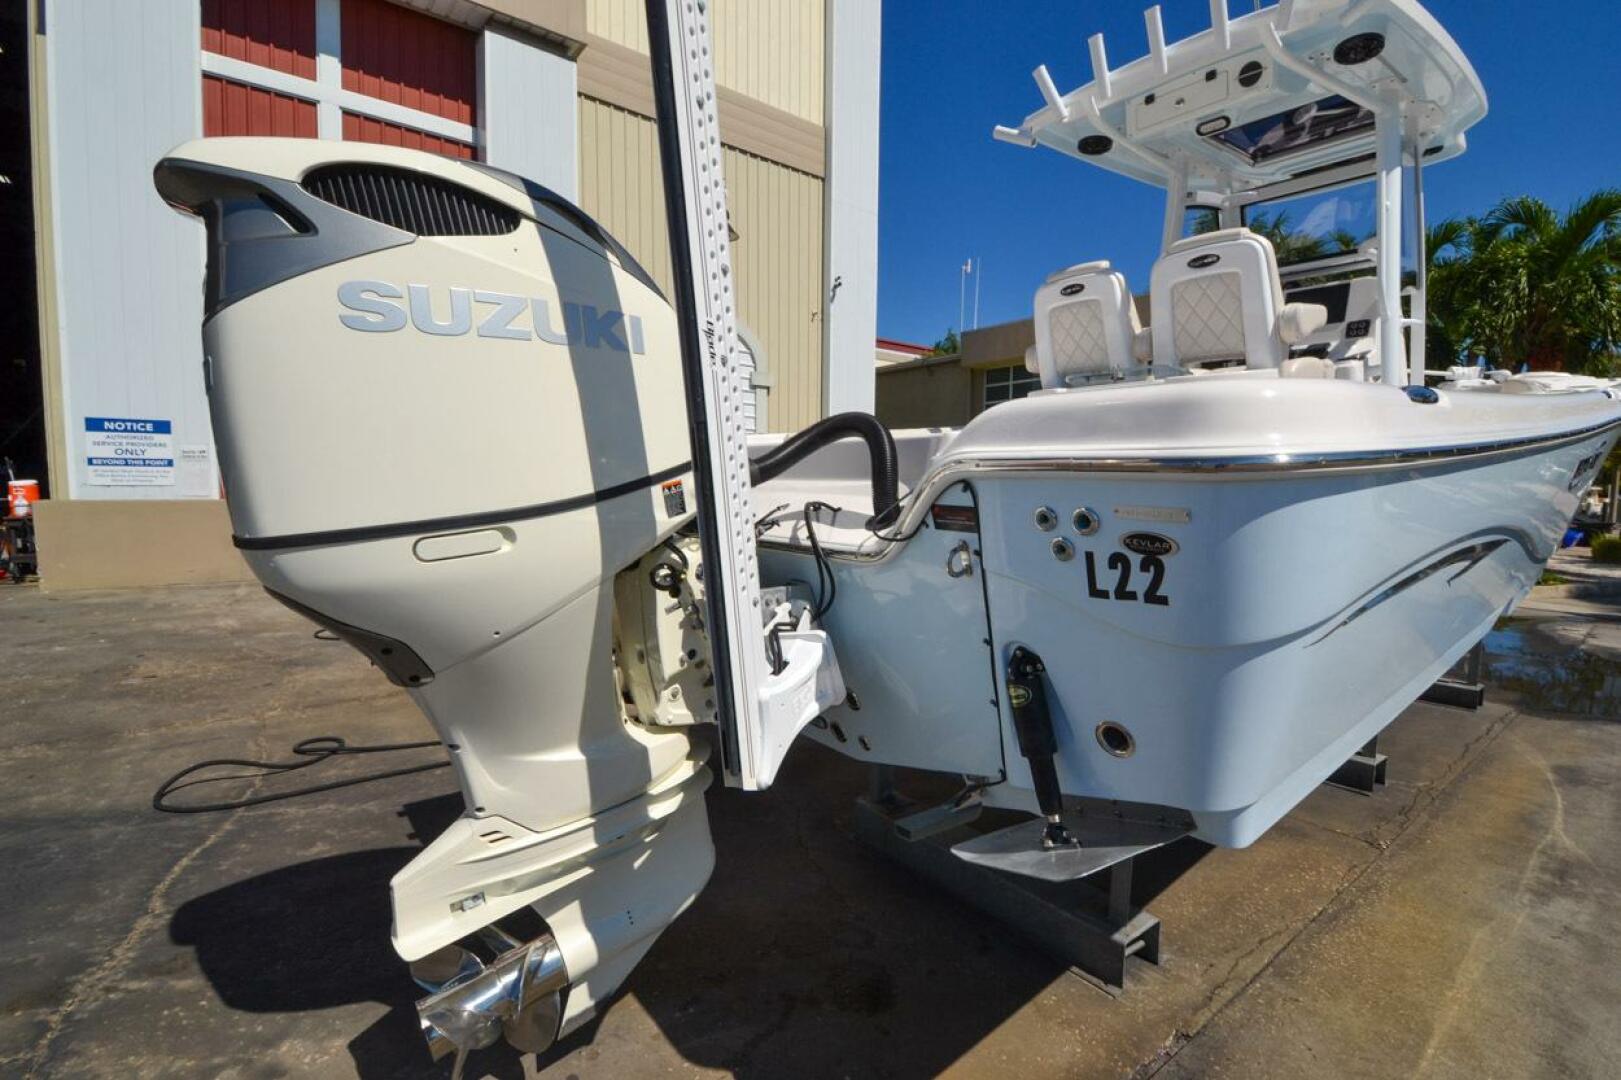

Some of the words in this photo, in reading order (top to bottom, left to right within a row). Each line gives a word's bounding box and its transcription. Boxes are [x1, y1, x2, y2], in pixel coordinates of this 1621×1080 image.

[337, 280, 645, 355] SUZUKI
[104, 421, 154, 431] NOTICE
[114, 448, 147, 456] ONLY
[1125, 538, 1170, 549] KEVLAR
[1085, 550, 1170, 606] L22
